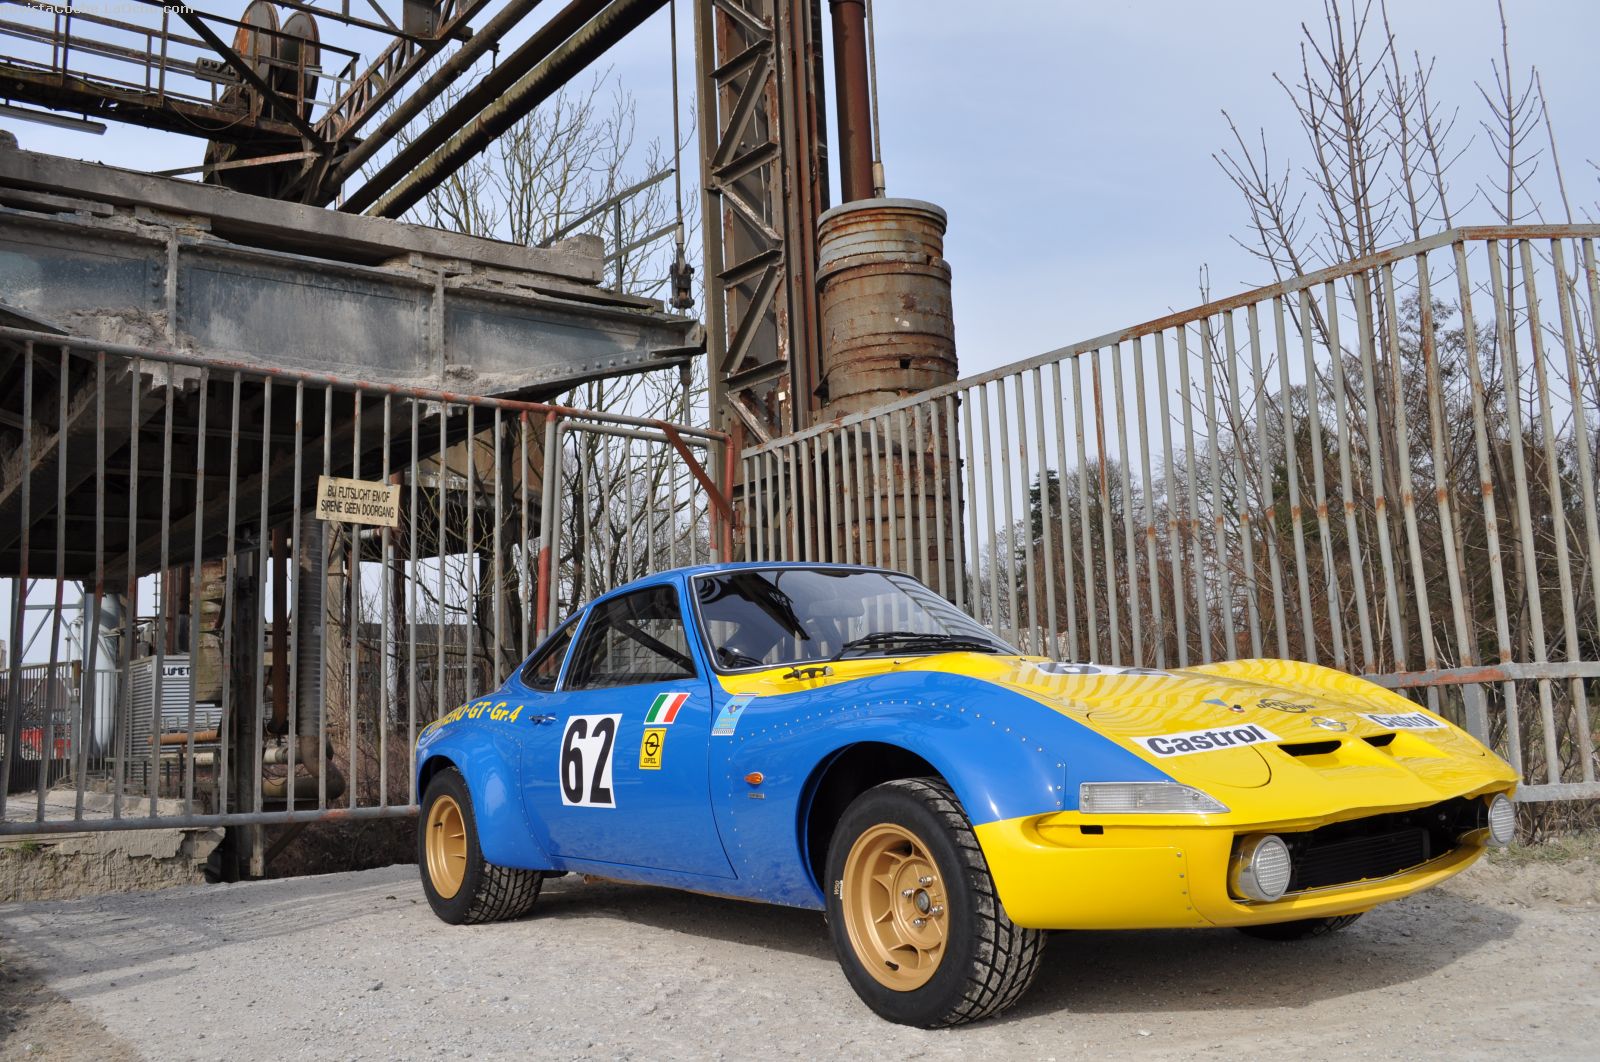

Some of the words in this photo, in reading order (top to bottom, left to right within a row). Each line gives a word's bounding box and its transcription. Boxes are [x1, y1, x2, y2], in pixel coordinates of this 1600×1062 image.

[321, 499, 343, 513] SIRENE
[344, 501, 360, 515] GEEN
[362, 504, 394, 518] DOORGANG
[1368, 713, 1439, 727] Castrol
[1147, 725, 1268, 755] Castrol
[561, 717, 616, 804] 62
